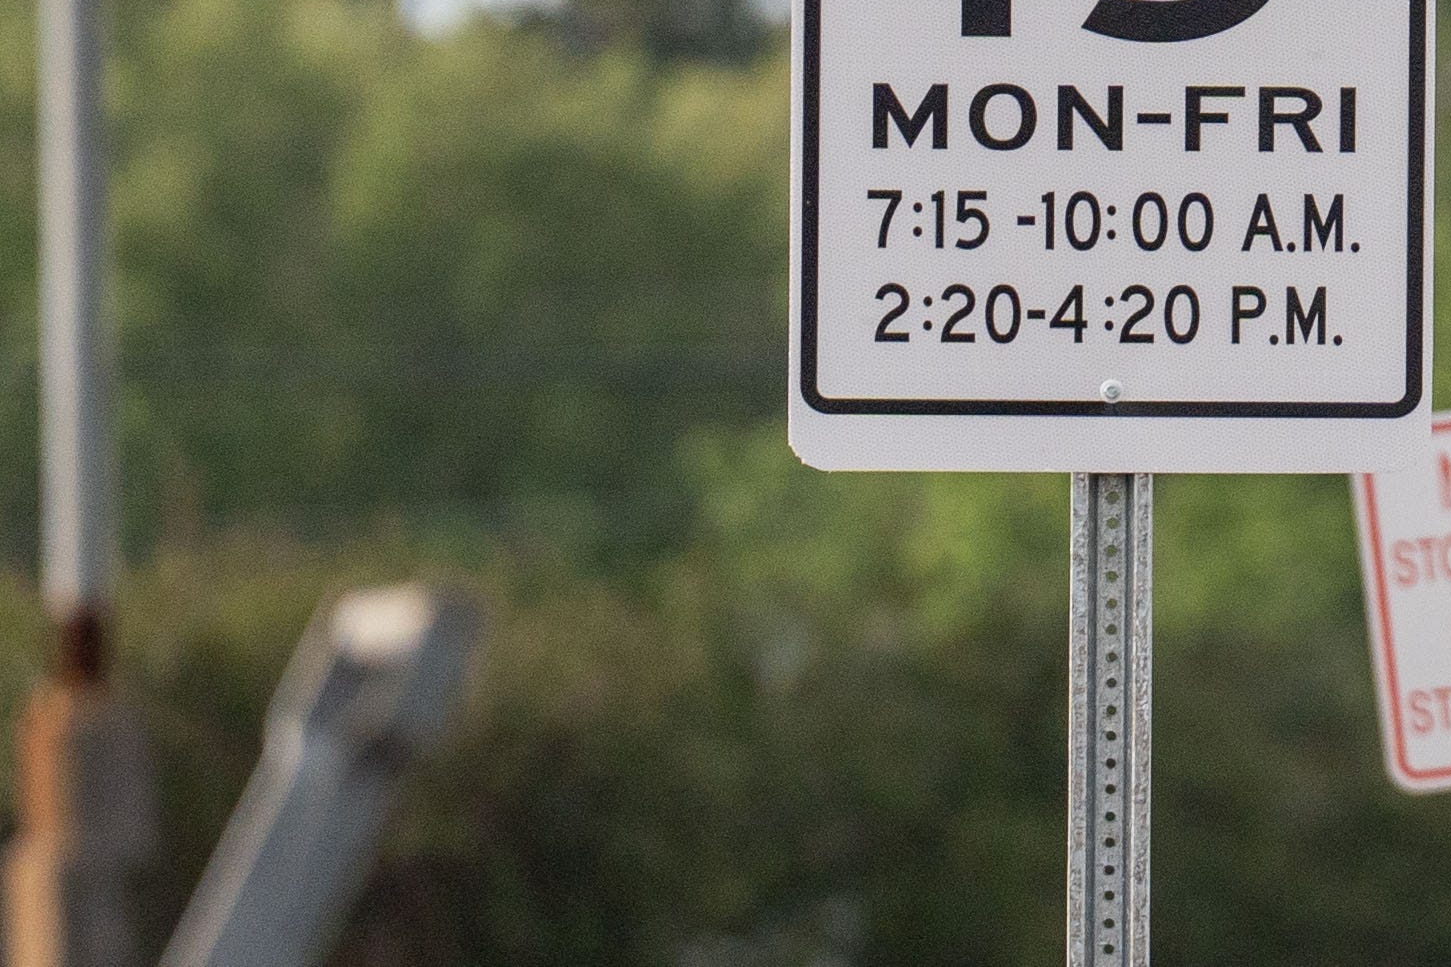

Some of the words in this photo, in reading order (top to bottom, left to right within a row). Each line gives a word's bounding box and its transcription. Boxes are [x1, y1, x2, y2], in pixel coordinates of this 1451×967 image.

[871, 82, 1358, 154] MON-FRI
[866, 189, 991, 250] 7:15
[1240, 192, 1362, 254] A.M.
[873, 282, 1201, 346] 2:20-4:20
[1230, 285, 1344, 347] P.M.
